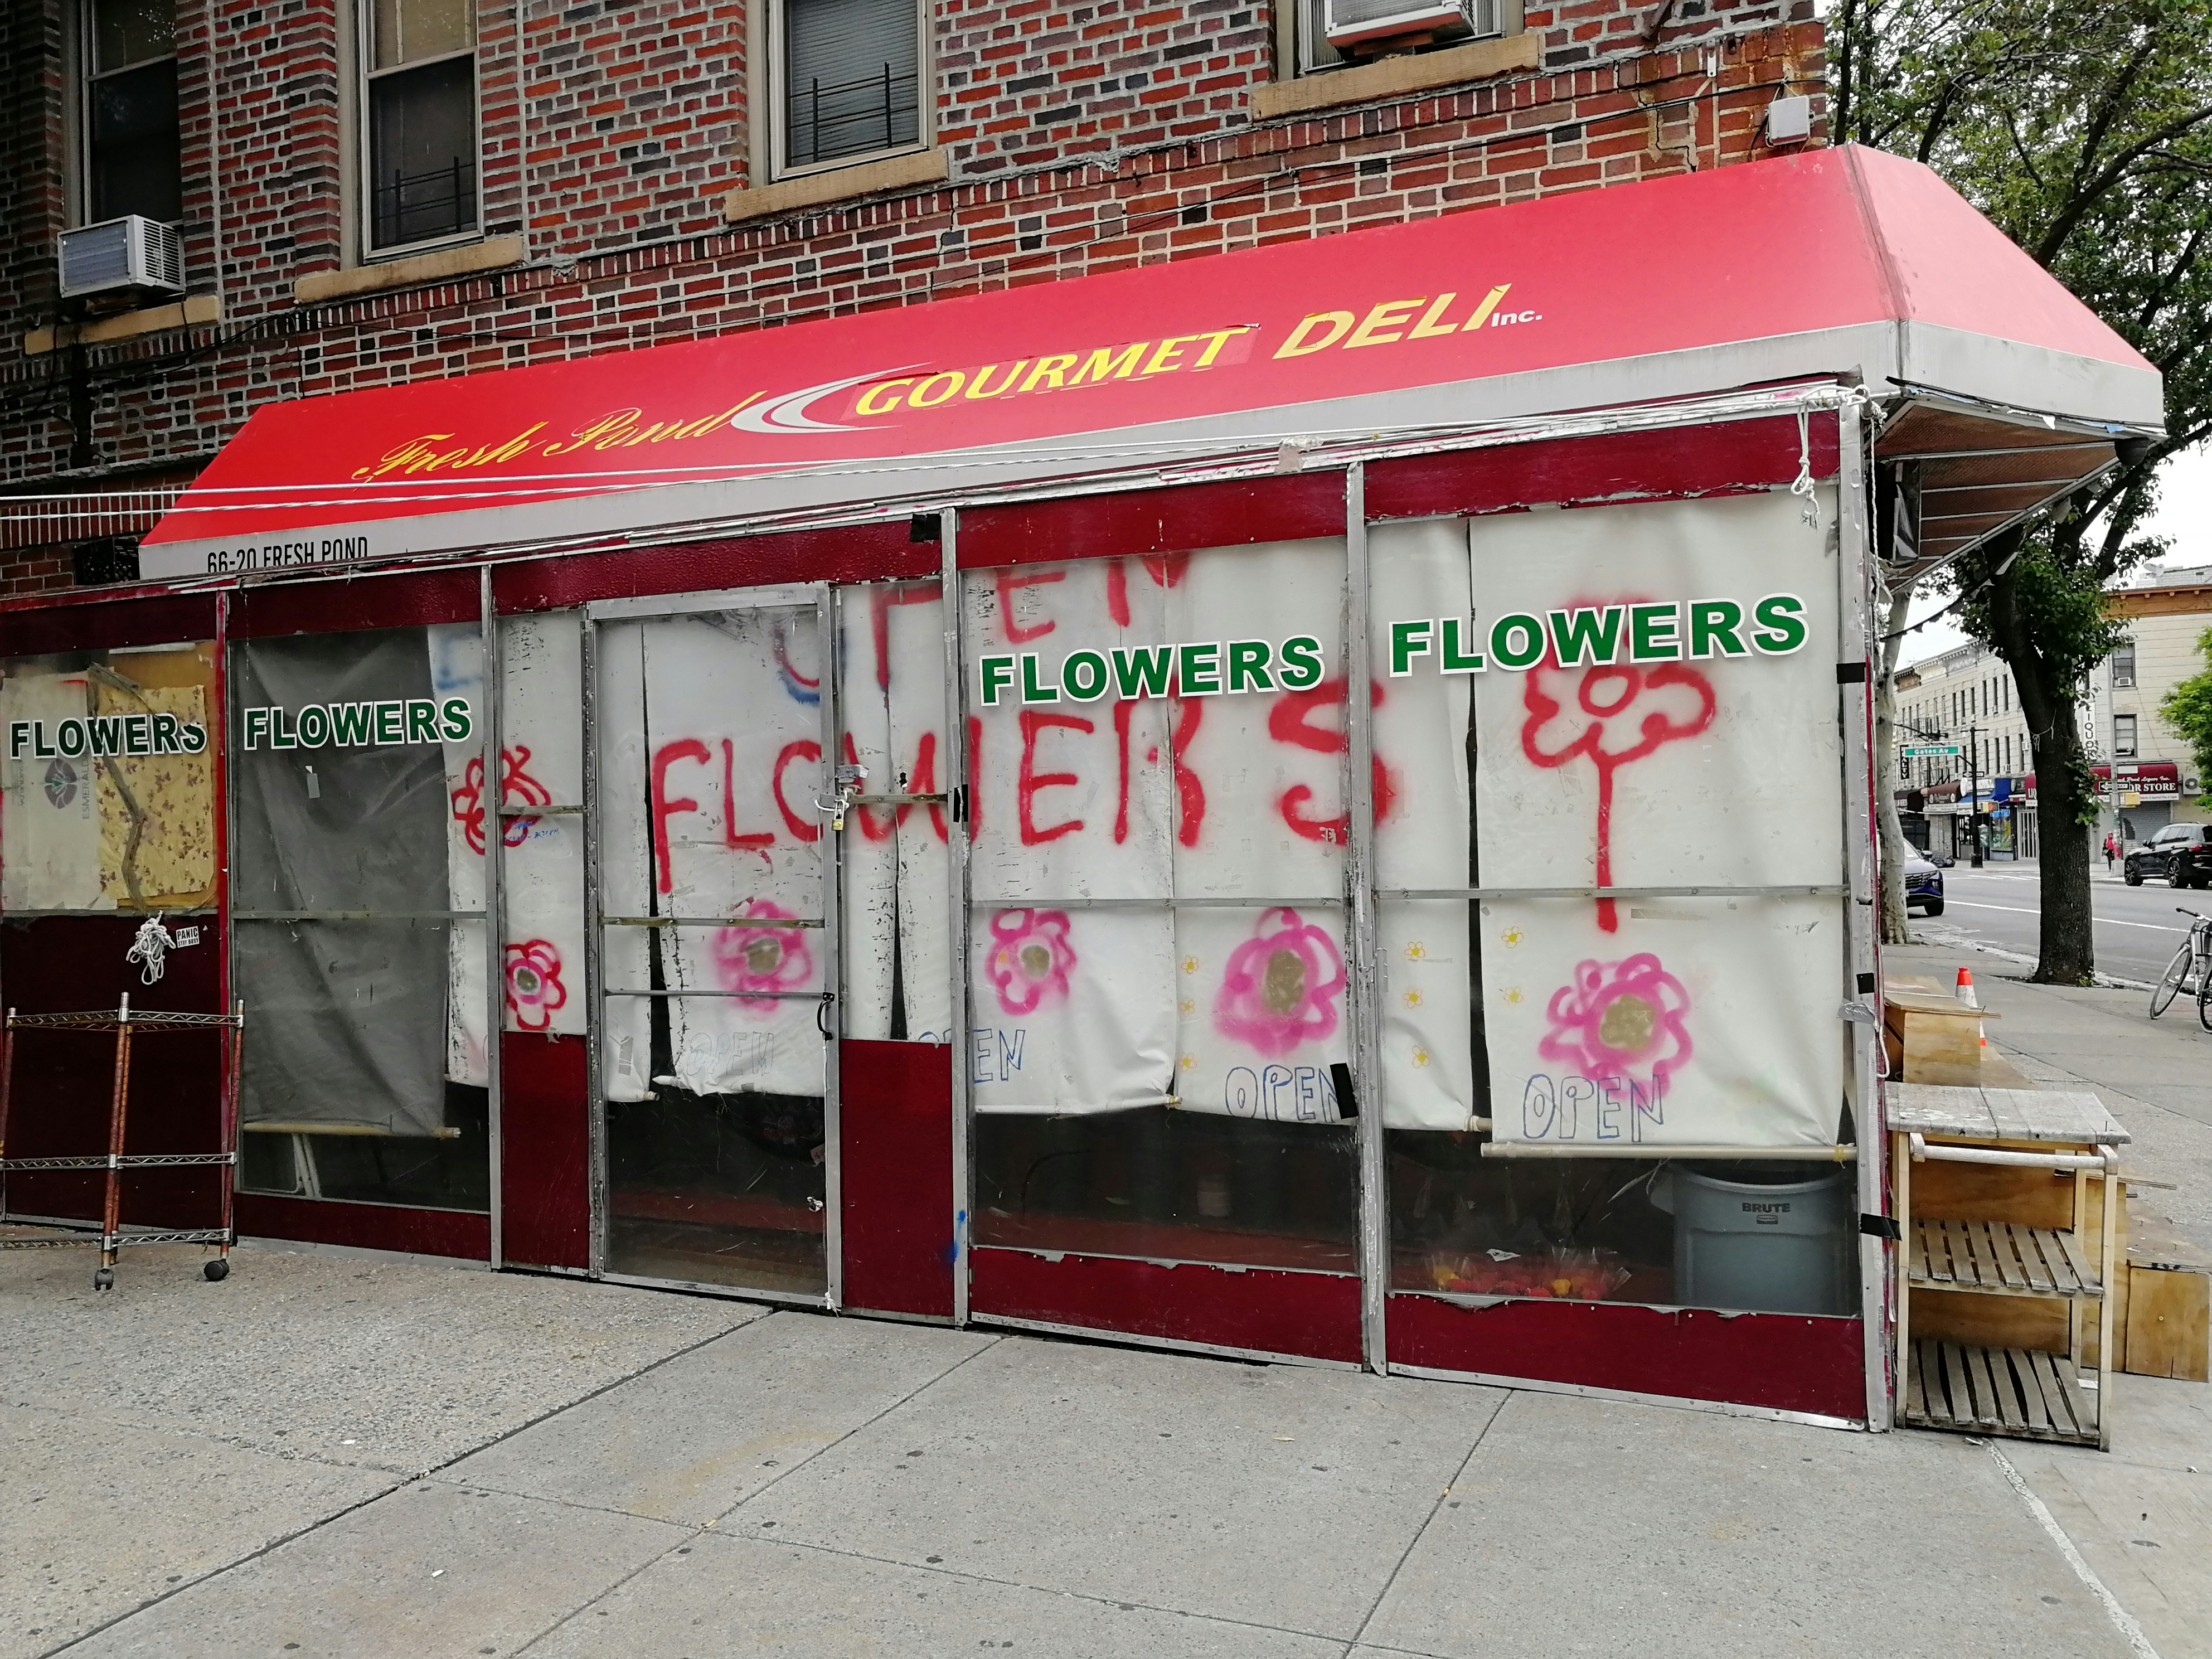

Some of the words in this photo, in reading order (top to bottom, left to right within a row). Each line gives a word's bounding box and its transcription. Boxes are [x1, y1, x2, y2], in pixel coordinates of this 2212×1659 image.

[351, 422, 549, 483] Fresh
[542, 391, 768, 457] Pond
[856, 328, 1250, 416] GOURMET
[1272, 283, 1511, 359] DELI
[1491, 310, 1542, 327] Inc.
[208, 549, 256, 573] 66-20
[264, 542, 314, 567] FRESH
[322, 537, 367, 561] POND
[1389, 592, 1810, 677] FLOWERS
[979, 634, 1325, 706] FLOWERS
[9, 714, 207, 759] FLOWERS
[244, 697, 473, 750] FLOWERS
[651, 676, 1395, 893] FLOWERS
[2143, 783, 2176, 792] STORE
[177, 928, 198, 940] PANIC
[919, 1029, 1026, 1084] EN
[1523, 1073, 1664, 1143] OPEN
[1742, 1202, 1791, 1212] BRUTE
